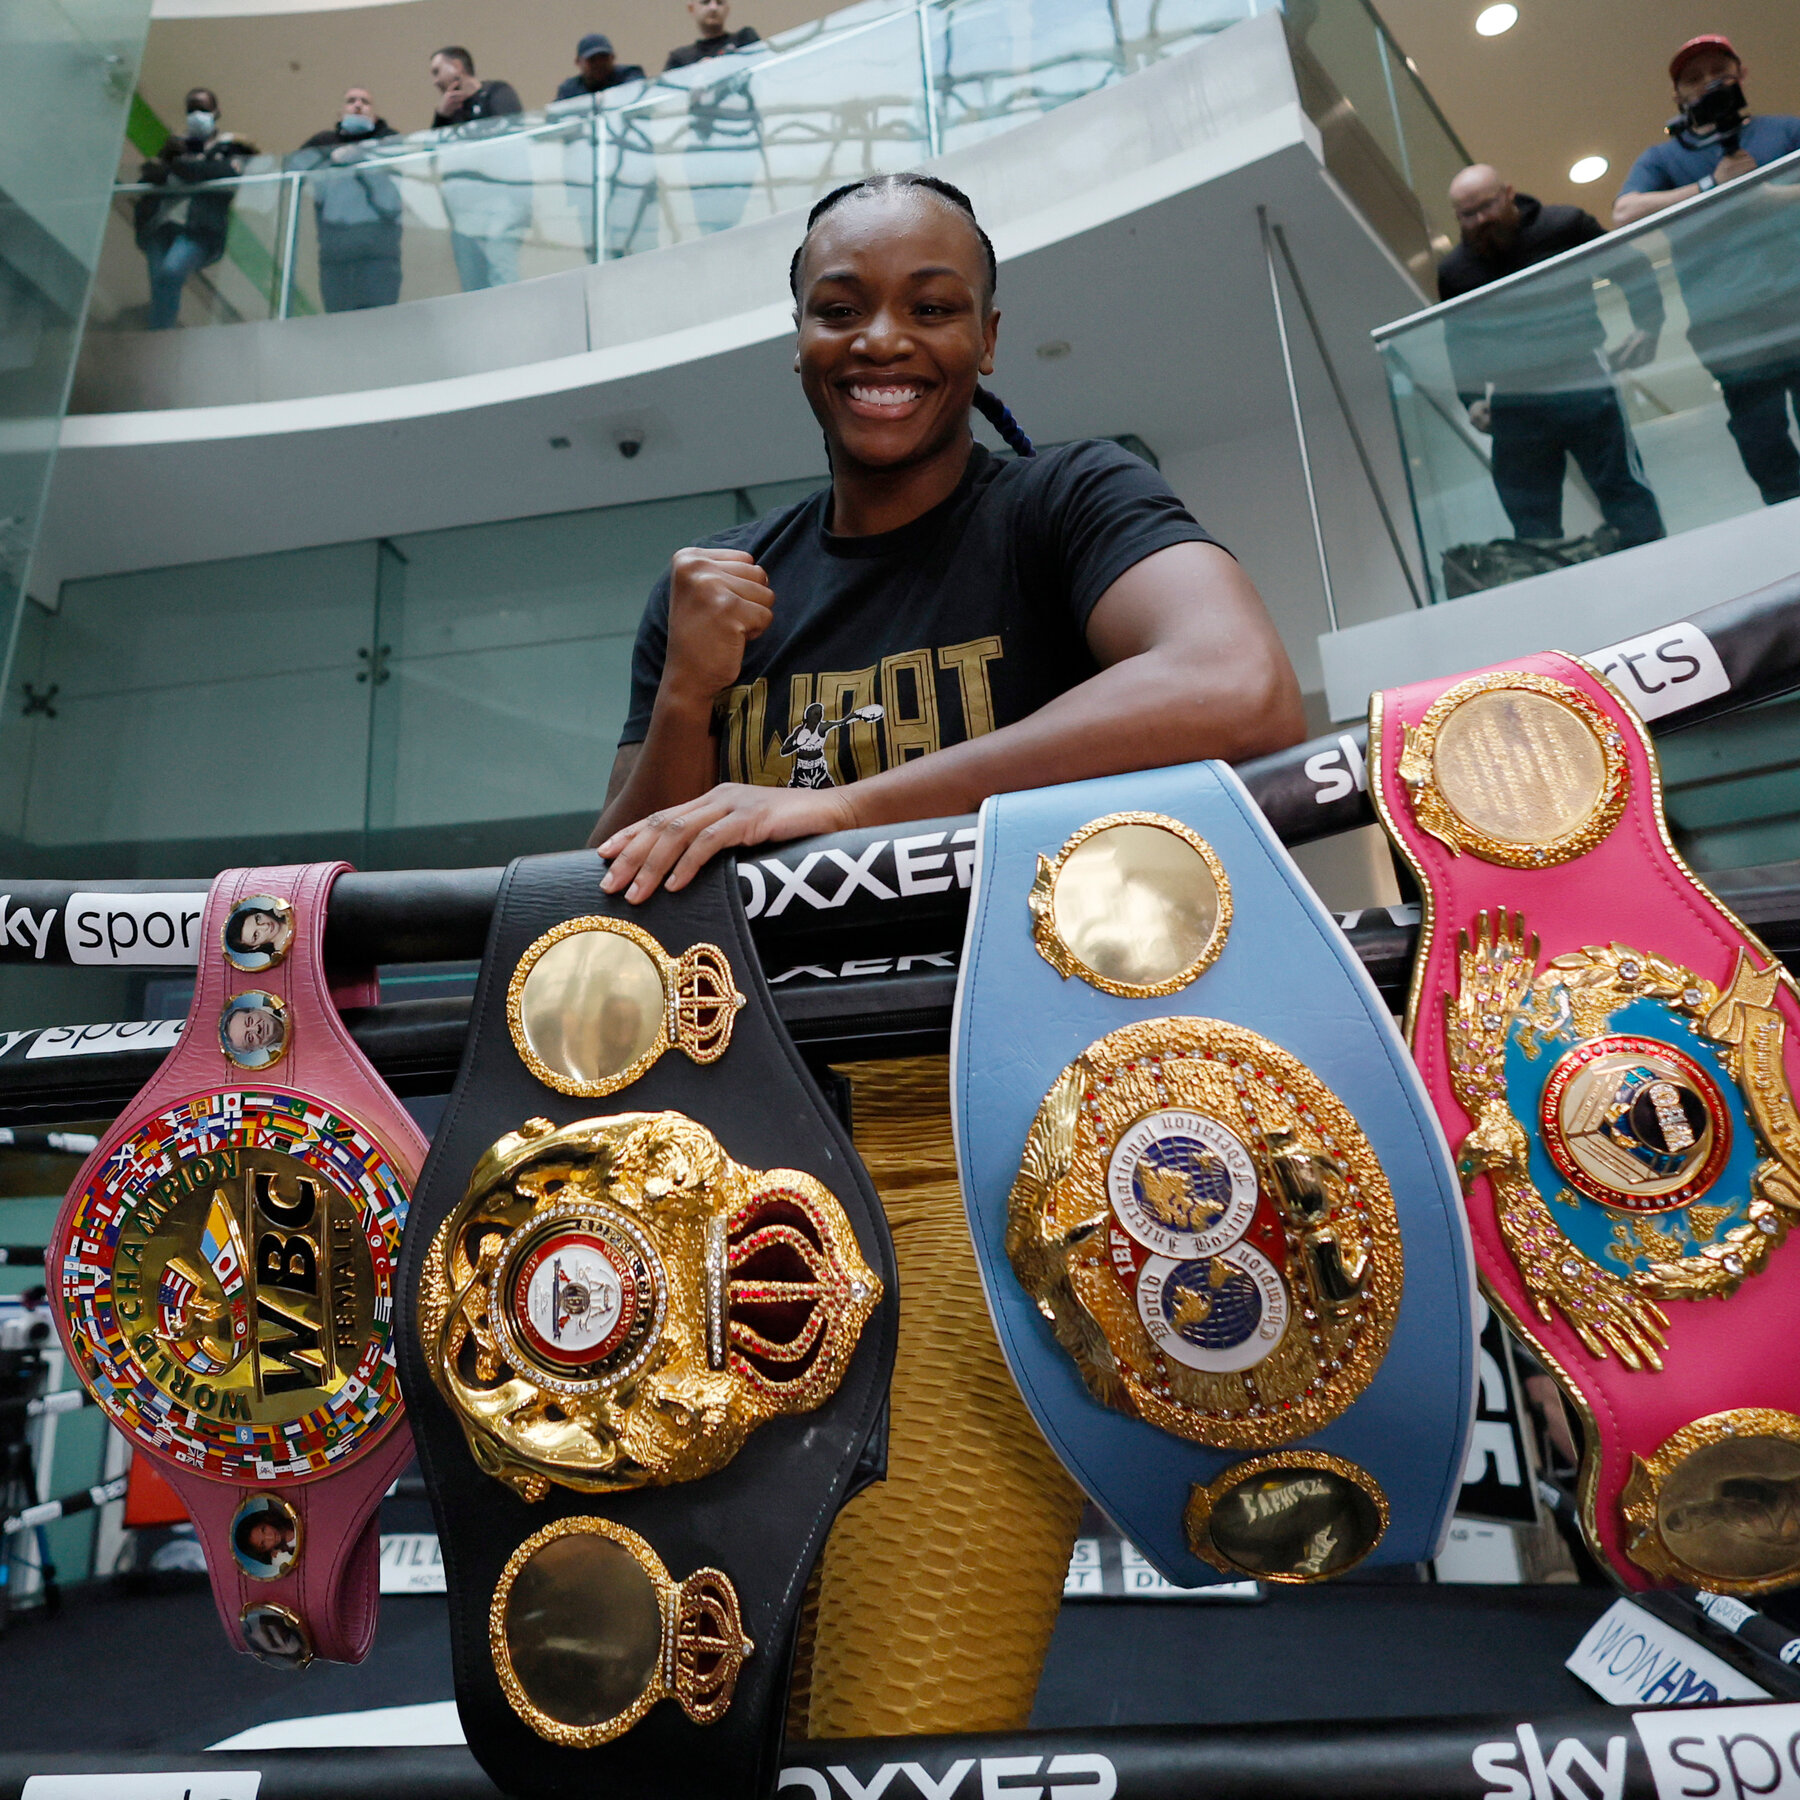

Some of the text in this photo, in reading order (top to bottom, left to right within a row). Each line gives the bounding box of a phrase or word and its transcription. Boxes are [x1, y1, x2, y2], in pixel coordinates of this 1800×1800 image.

[116, 1150, 240, 1322] CHAMPION
[603, 1243, 634, 1292] WORLD
[1109, 1228, 1137, 1277] IBF
[1192, 1199, 1254, 1253] Boxing
[254, 1173, 329, 1397] WBC
[333, 1217, 359, 1350] FEMALE
[136, 1331, 253, 1421] WORLD
[1588, 1616, 1735, 1705] WOWHYD
[1472, 1723, 1627, 1800] sky
